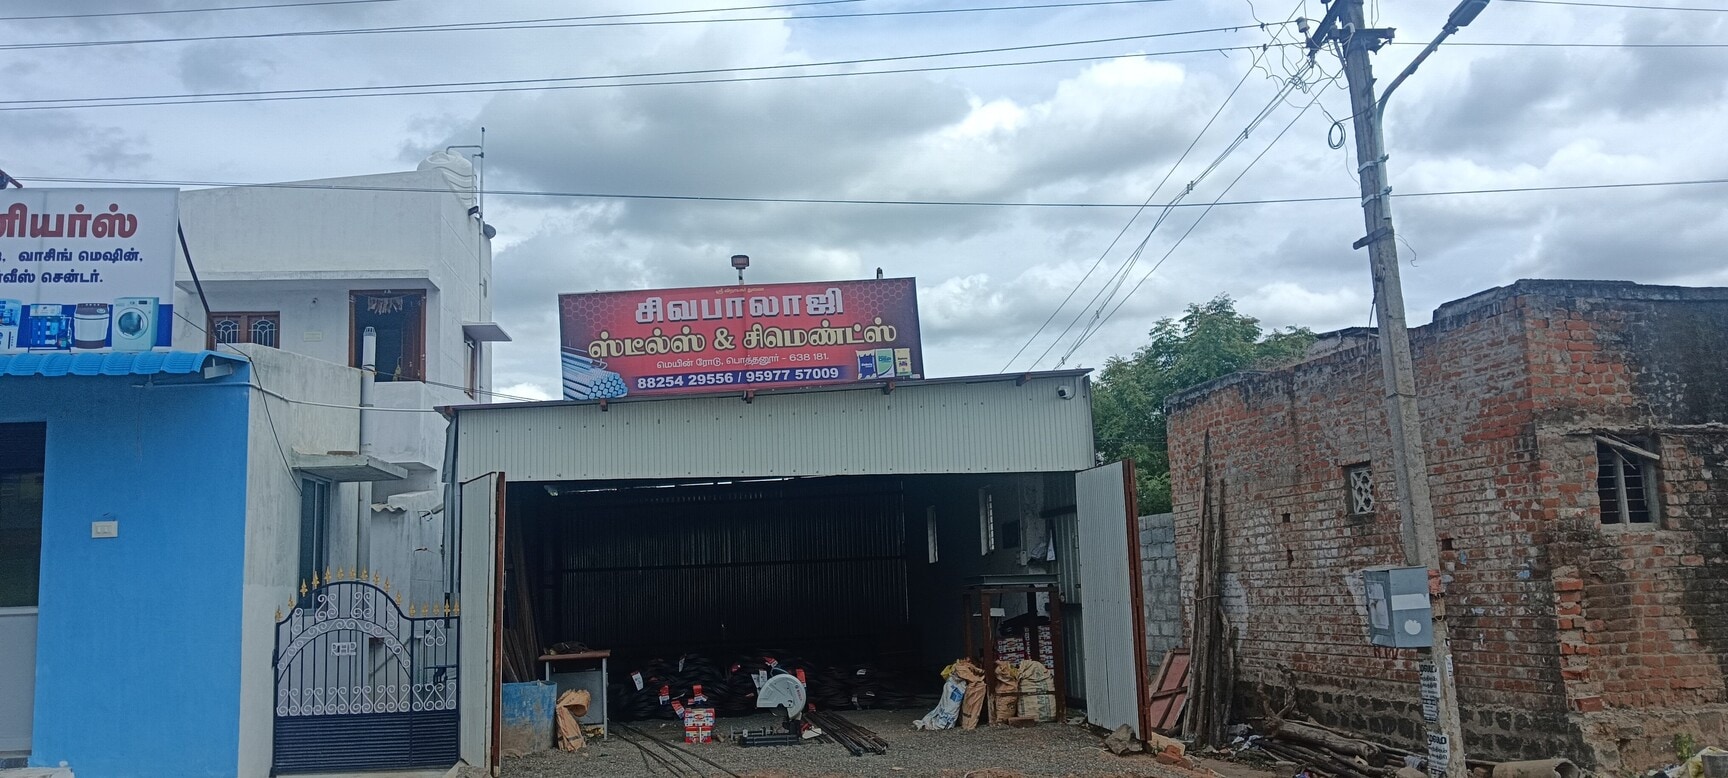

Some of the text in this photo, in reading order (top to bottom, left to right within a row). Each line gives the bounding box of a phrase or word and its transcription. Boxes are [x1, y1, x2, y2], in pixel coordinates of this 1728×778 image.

[18, 248, 73, 262] வாசிங்
[78, 247, 143, 263] மெஷின்,
[0, 268, 103, 283] வீஸ் சென்டர்.
[635, 288, 844, 323] சிவபாலாஜி
[589, 317, 897, 358] ஸ்டீல்ஸ் & சிமெண்ட்ஸ்
[656, 358, 693, 369] மெயின்
[695, 357, 724, 367] ரோடு,
[726, 353, 779, 367] பொத்தனூர்
[789, 353, 811, 362] 638
[813, 352, 829, 361] 181.
[637, 367, 839, 389] 88254 29556 / 95977 57009
